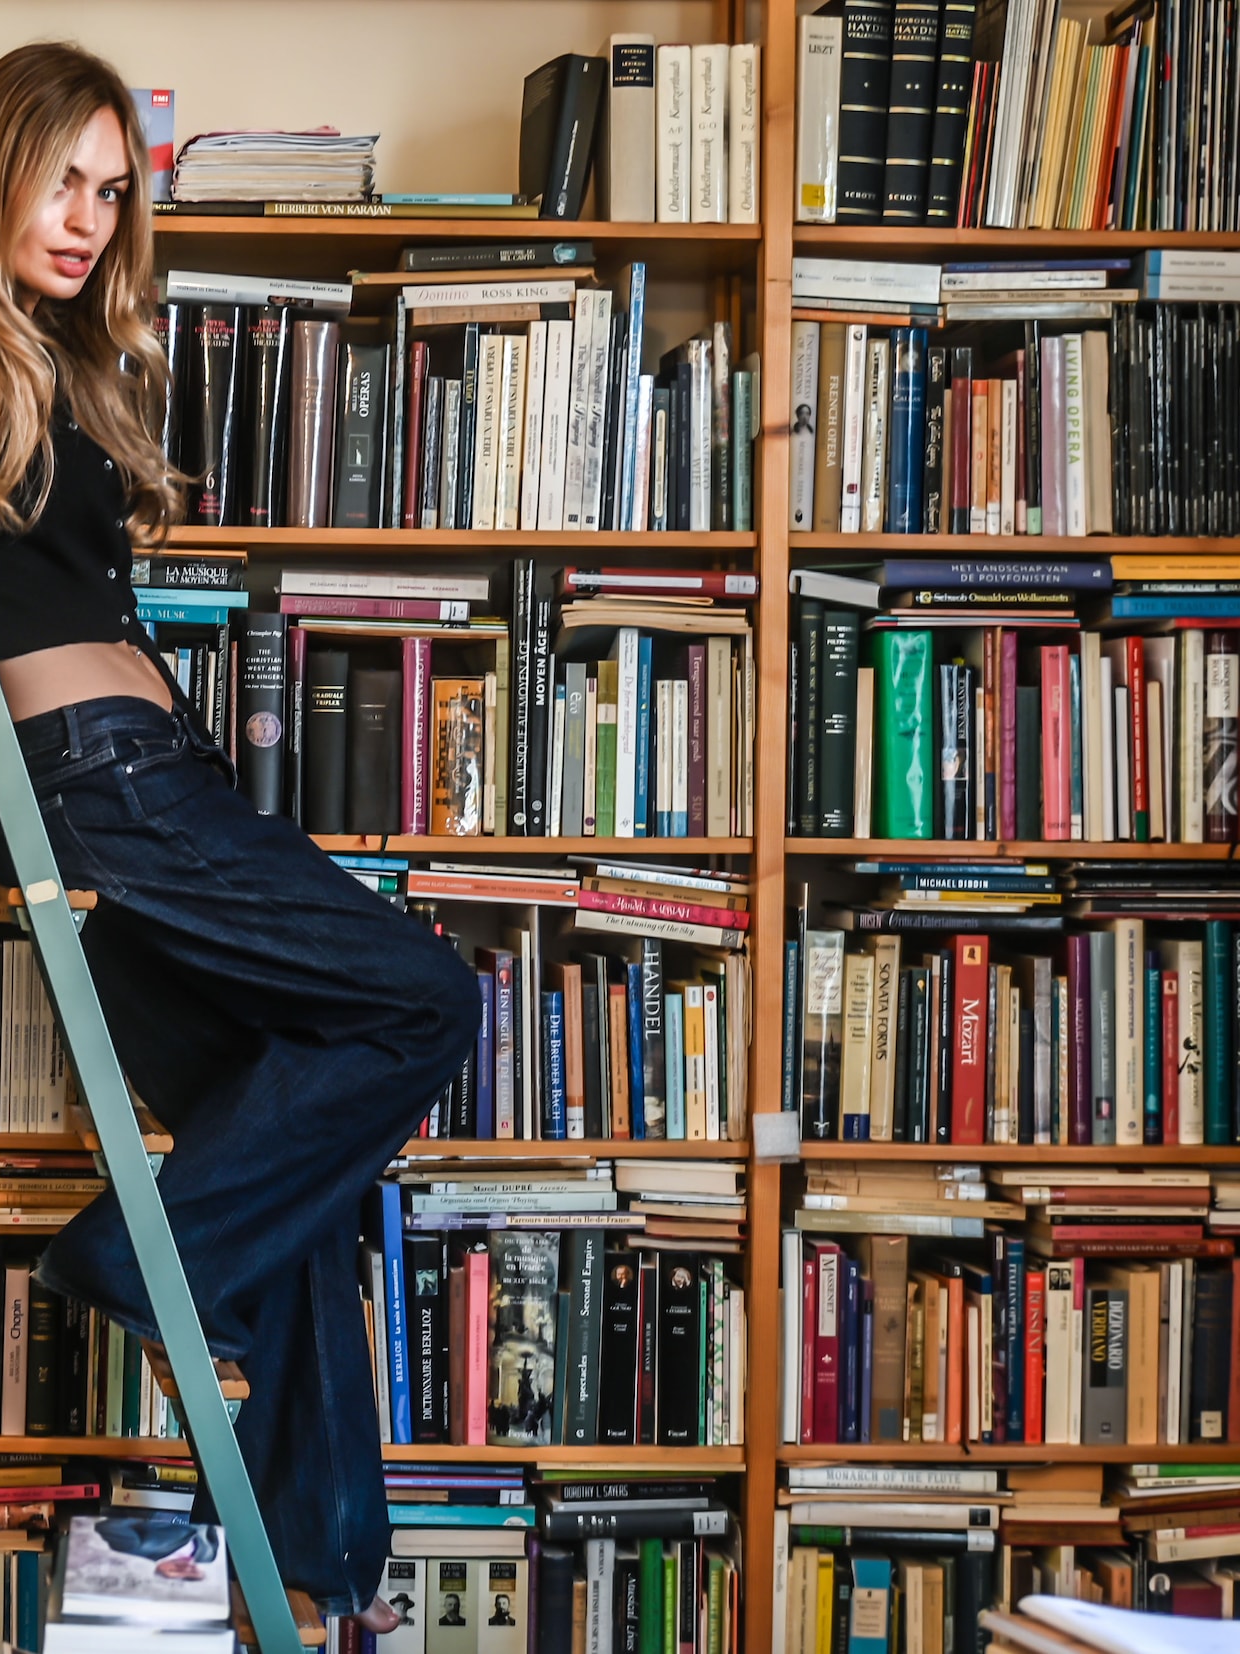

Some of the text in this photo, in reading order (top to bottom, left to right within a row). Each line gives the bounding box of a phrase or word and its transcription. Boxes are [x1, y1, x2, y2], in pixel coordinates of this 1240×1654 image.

[808, 44, 834, 55] LISZT
[895, 25, 937, 35] HAYDN
[274, 204, 391, 217] HERBERT VON KARAJAN
[417, 287, 548, 302] Domino ROSS KING
[827, 376, 839, 468] FRENCH OPERA
[1065, 339, 1079, 466] LIVING OPERA
[952, 565, 1068, 573] HET LANDSCHAP VAN
[961, 574, 1060, 583] DE POLYFONISTEN
[536, 660, 546, 706] MOYEN
[920, 879, 988, 888] MICHAEL DIBDIN
[605, 916, 620, 925] The
[620, 917, 658, 931] Untuning
[658, 921, 666, 931] of
[667, 923, 679, 933] the
[644, 950, 659, 1040] HANDEL
[876, 963, 890, 1060] SONATA FORMS
[961, 998, 980, 1066] Mozart
[502, 1183, 532, 1191] DUPRÉ
[10, 1298, 21, 1340] Chopin
[394, 1300, 399, 1308] du
[579, 1239, 593, 1402] spectacles Second Empire
[395, 1326, 401, 1335] La
[1092, 1302, 1107, 1363] VERDIANO
[1109, 1302, 1123, 1369] DIZIONARIO
[396, 1341, 404, 1382] BERLIOZ
[422, 1309, 433, 1420] DICTIONNAIRE BERLIOZ
